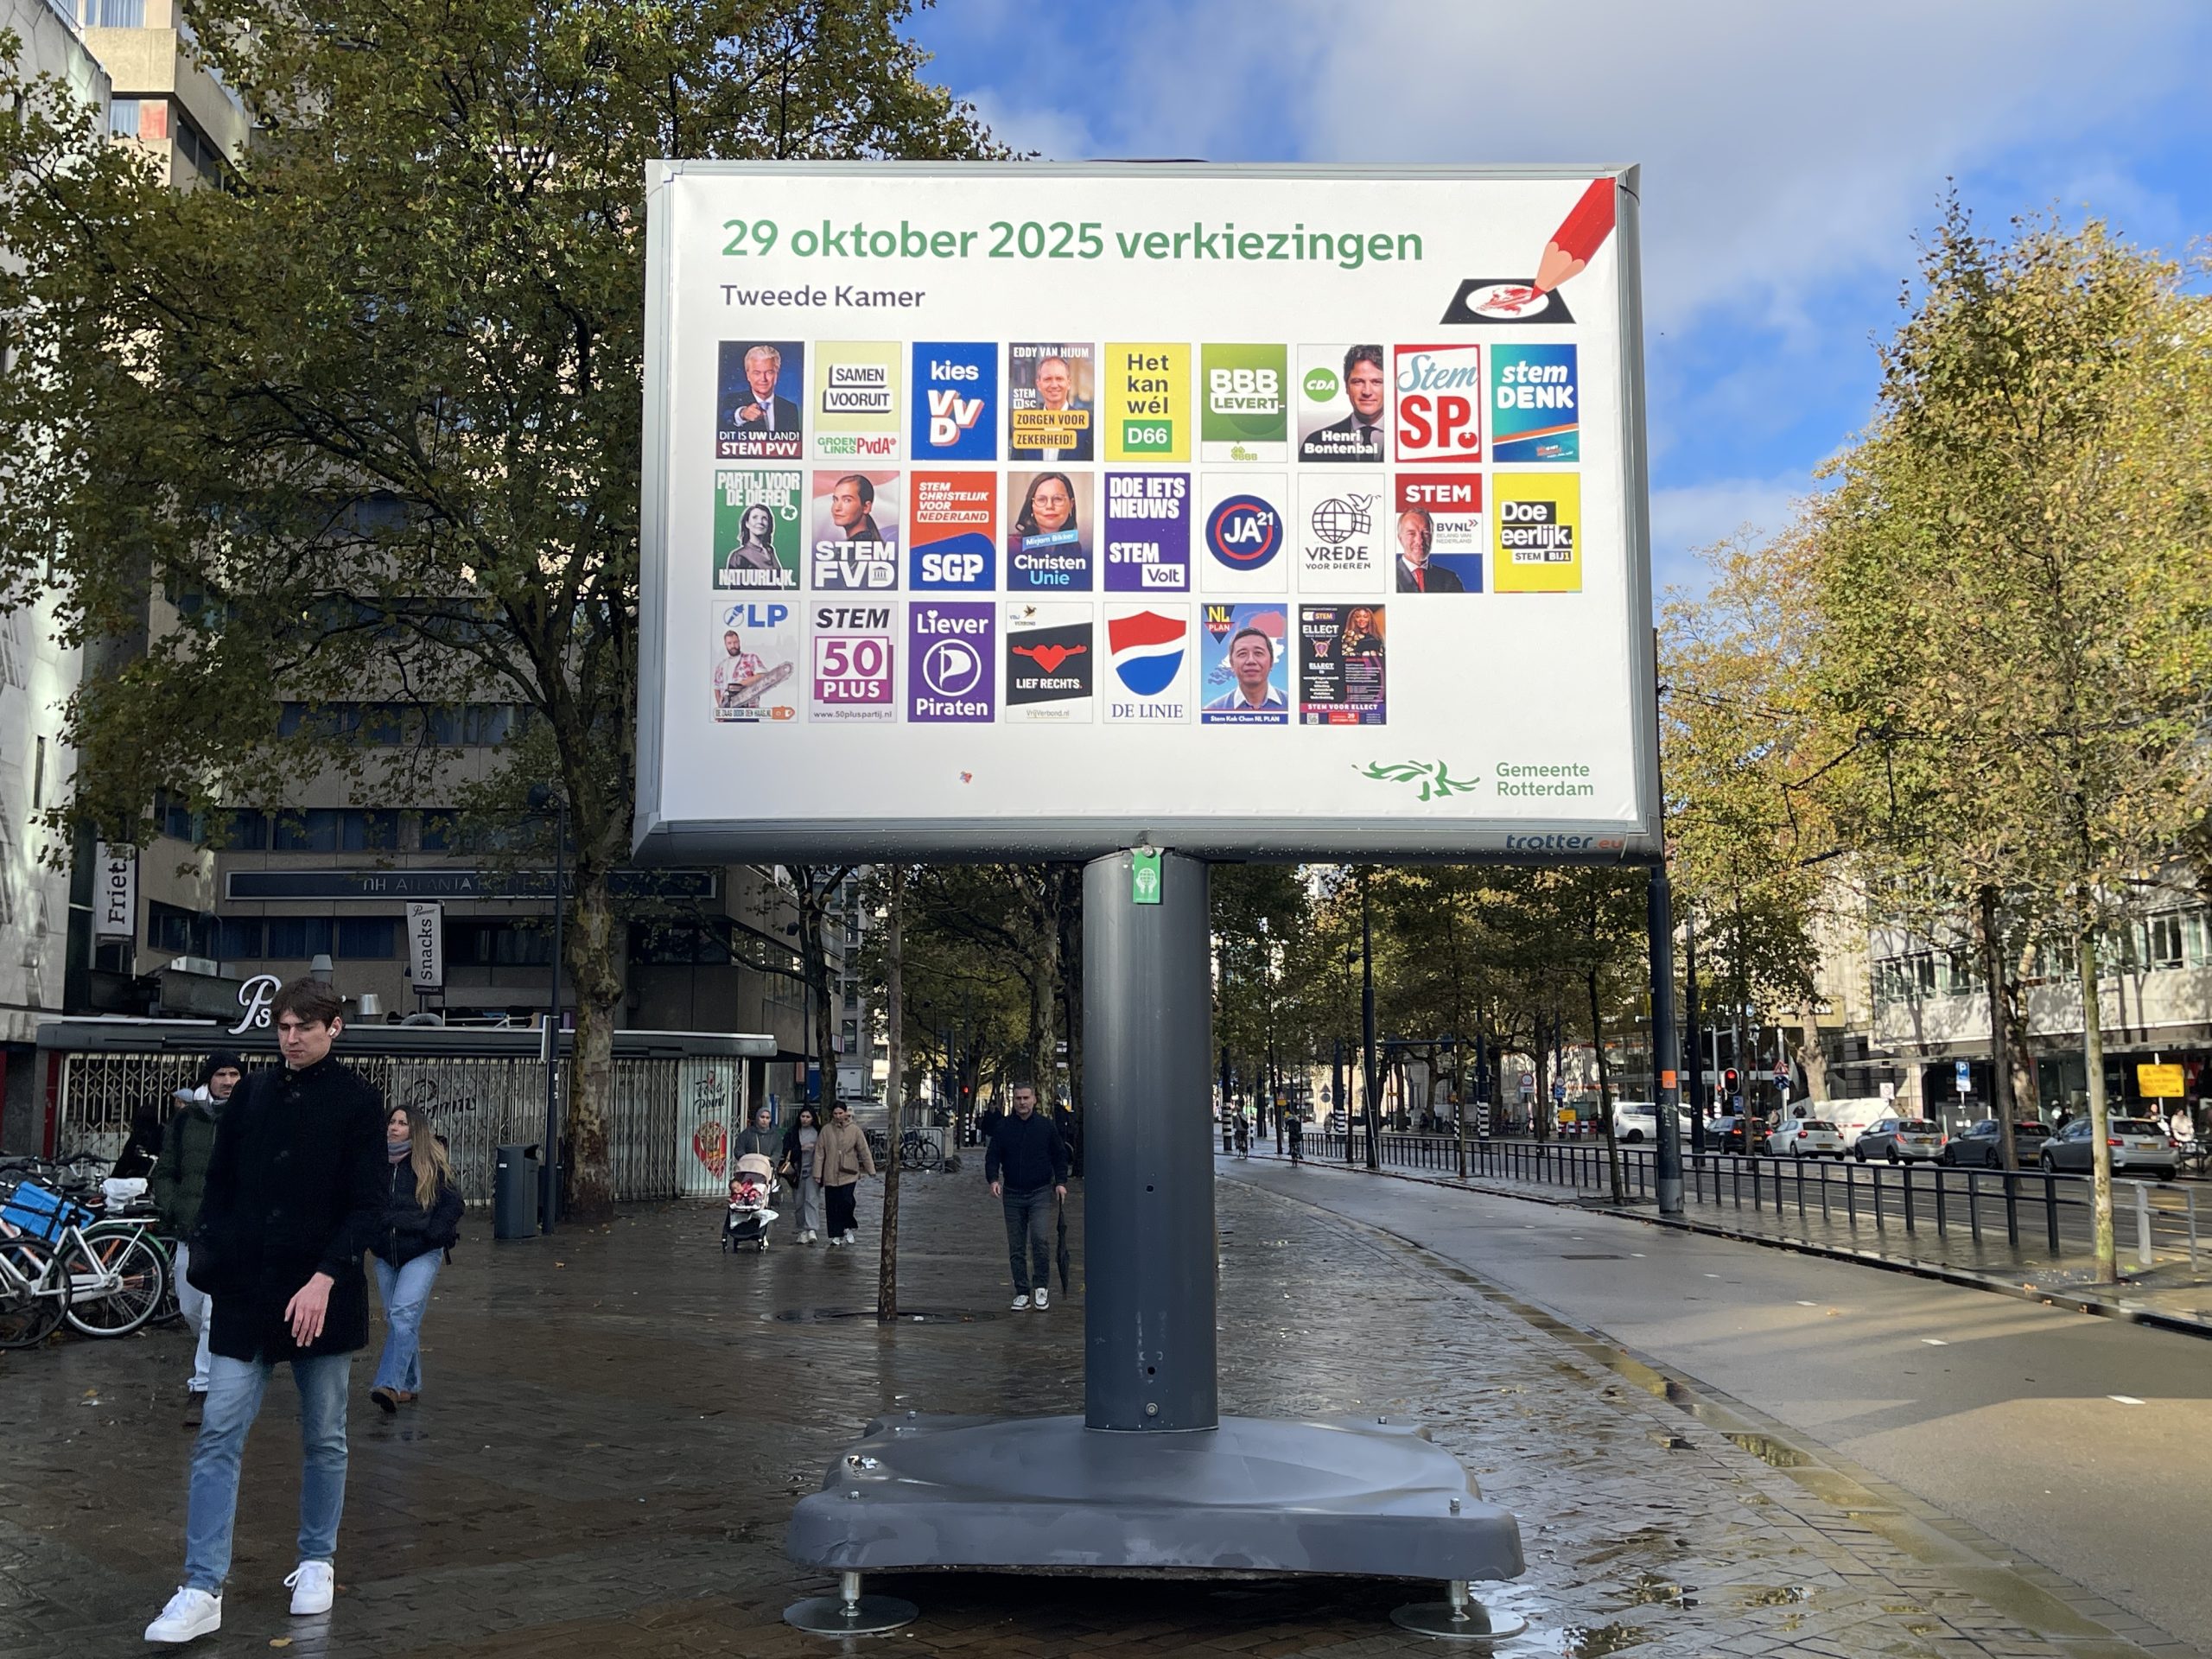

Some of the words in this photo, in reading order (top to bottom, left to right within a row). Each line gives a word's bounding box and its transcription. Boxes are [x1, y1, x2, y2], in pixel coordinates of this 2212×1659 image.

[721, 219, 779, 257] 29
[791, 219, 978, 257] oktober
[988, 220, 1104, 259] 2025
[1116, 223, 1423, 270] verkiezingen
[721, 284, 827, 308] Tweede
[835, 285, 926, 308] Kamer
[1014, 347, 1037, 358] EDDY
[1040, 347, 1058, 358] VAN
[1060, 347, 1089, 358] HIJUM
[931, 360, 979, 380] kies
[1128, 353, 1169, 371] Het
[836, 368, 885, 381] SAMEN
[1396, 354, 1479, 392] Stem
[1502, 360, 1567, 383] stem
[1128, 375, 1168, 392] kan
[1210, 368, 1279, 393] BBB
[1306, 379, 1336, 391] CDA
[830, 392, 890, 406] VOORUIT
[1014, 389, 1035, 398] STEM
[1497, 385, 1574, 409] DENK
[1127, 396, 1168, 414] wél
[1017, 415, 1055, 425] ZORGEN
[1058, 415, 1085, 425] VOOR
[719, 431, 735, 441] DIT
[738, 431, 746, 441] IS
[748, 432, 767, 441] UW
[769, 432, 799, 441] LAND!
[1017, 434, 1072, 445] ZEKERHEID!
[1128, 428, 1167, 444] D66
[1322, 430, 1361, 442] Henri
[721, 443, 762, 455] STEM
[766, 443, 797, 455] PVV
[824, 445, 855, 454] LINKS
[856, 438, 890, 454] PvdA
[1304, 443, 1378, 454] Bontenbal
[717, 472, 764, 491] PARTIJ
[765, 473, 800, 491] VOOR
[919, 482, 950, 491] STEM
[1109, 477, 1142, 498] DOE
[1147, 478, 1185, 498] IETS
[726, 490, 744, 506] DE
[746, 490, 791, 506] DIEREN
[919, 493, 989, 501] CHRISTELIJK
[1405, 485, 1471, 503] STEM
[919, 501, 950, 510] VOOR
[1109, 499, 1179, 518] NIEUWS
[1502, 501, 1547, 521] Doe
[919, 512, 988, 521] NEDERLAND
[1437, 523, 1471, 532] BVNL
[1502, 525, 1573, 550] eerlijk.
[816, 541, 895, 561] STEM
[1109, 543, 1160, 563] STEM
[1306, 546, 1369, 561] VREDE
[1516, 552, 1541, 561] STEM
[922, 553, 984, 582] SGP
[1014, 554, 1086, 570] Christen
[719, 569, 796, 586] NATUURLIJK.
[815, 561, 895, 588] FVD
[1030, 570, 1070, 585] Unie
[1147, 569, 1179, 582] Volt
[747, 604, 789, 627] LP
[816, 608, 890, 629] STEM
[917, 610, 988, 633] Liever
[1209, 607, 1230, 622] NL
[1303, 625, 1339, 633] ELLECT
[823, 639, 883, 677] 50
[823, 681, 880, 698] PLUS
[1016, 678, 1038, 689] LIEF
[916, 698, 988, 716] Piraten
[1112, 704, 1135, 718] DE
[1140, 704, 1183, 718] LINIE
[1497, 762, 1590, 777] Gemeente
[1497, 781, 1594, 797] Rotterdam
[417, 918, 433, 981] Snacks
